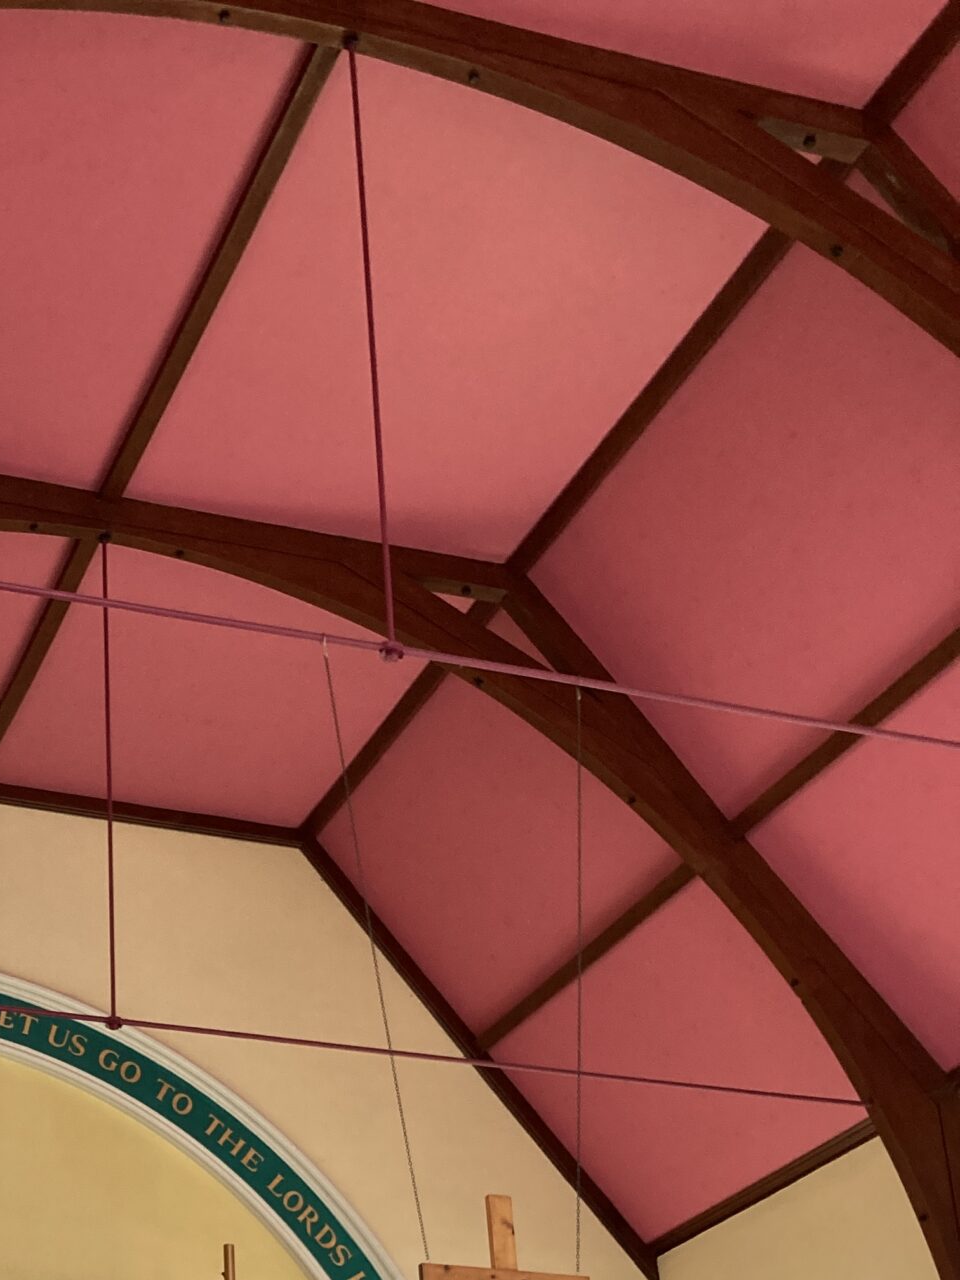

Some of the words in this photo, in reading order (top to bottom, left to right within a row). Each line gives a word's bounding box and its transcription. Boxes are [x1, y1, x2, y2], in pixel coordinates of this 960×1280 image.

[48, 1024, 88, 1057] US
[98, 1048, 142, 1083] GO
[155, 1078, 193, 1116] TO
[205, 1114, 265, 1172] THE
[266, 1173, 353, 1267] LORDS
